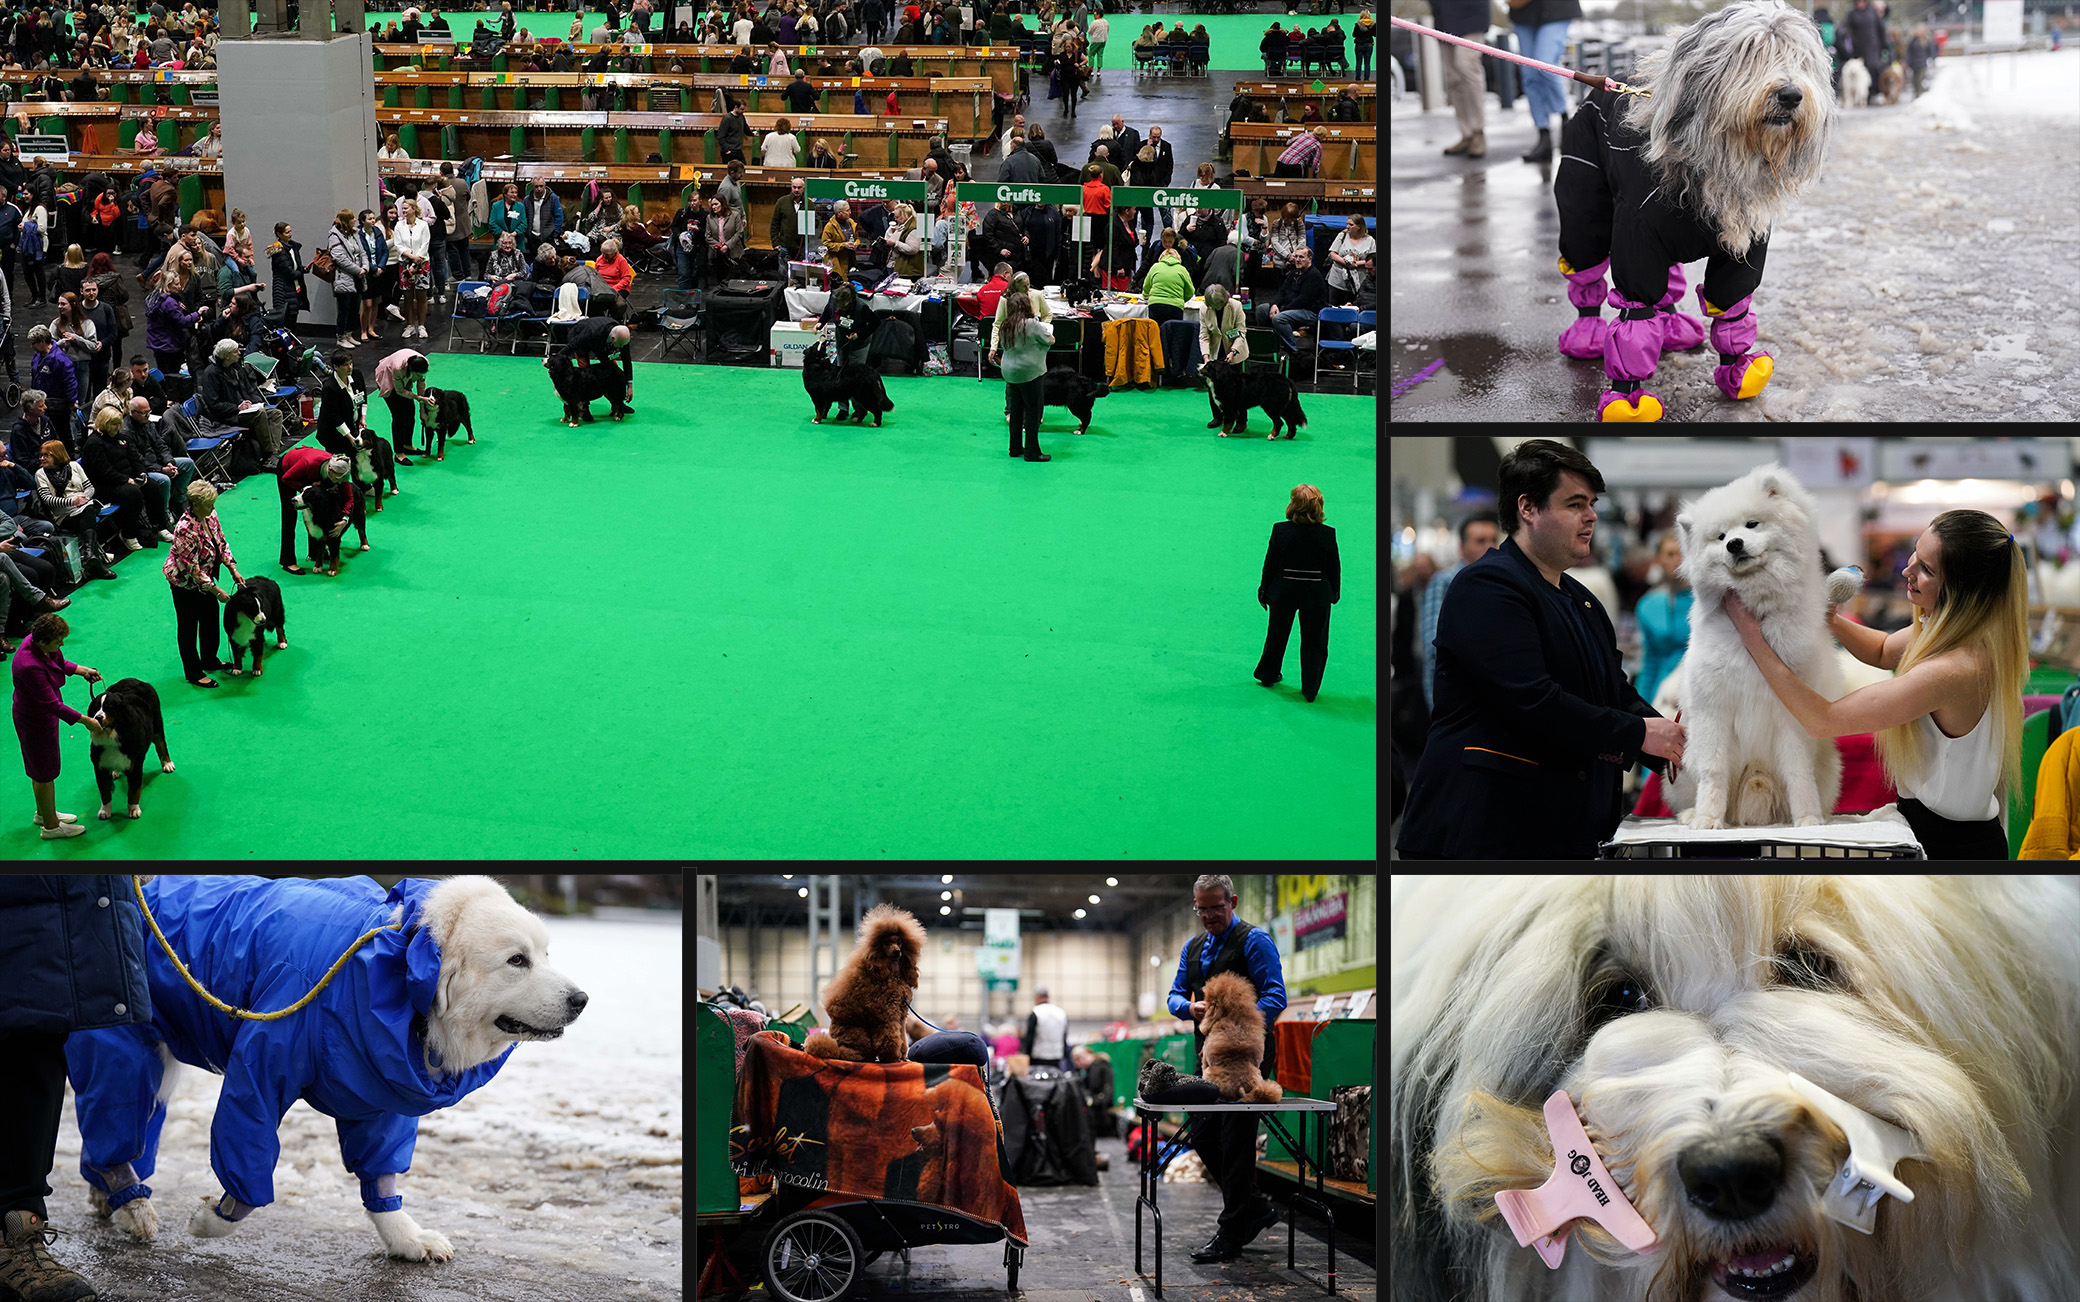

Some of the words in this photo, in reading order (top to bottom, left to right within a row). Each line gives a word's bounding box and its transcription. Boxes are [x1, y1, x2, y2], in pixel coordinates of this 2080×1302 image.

[844, 181, 888, 198] Crufts
[996, 185, 1042, 202] Crufts
[1152, 189, 1199, 207] Crufts
[1587, 1178, 1611, 1207] HEAD
